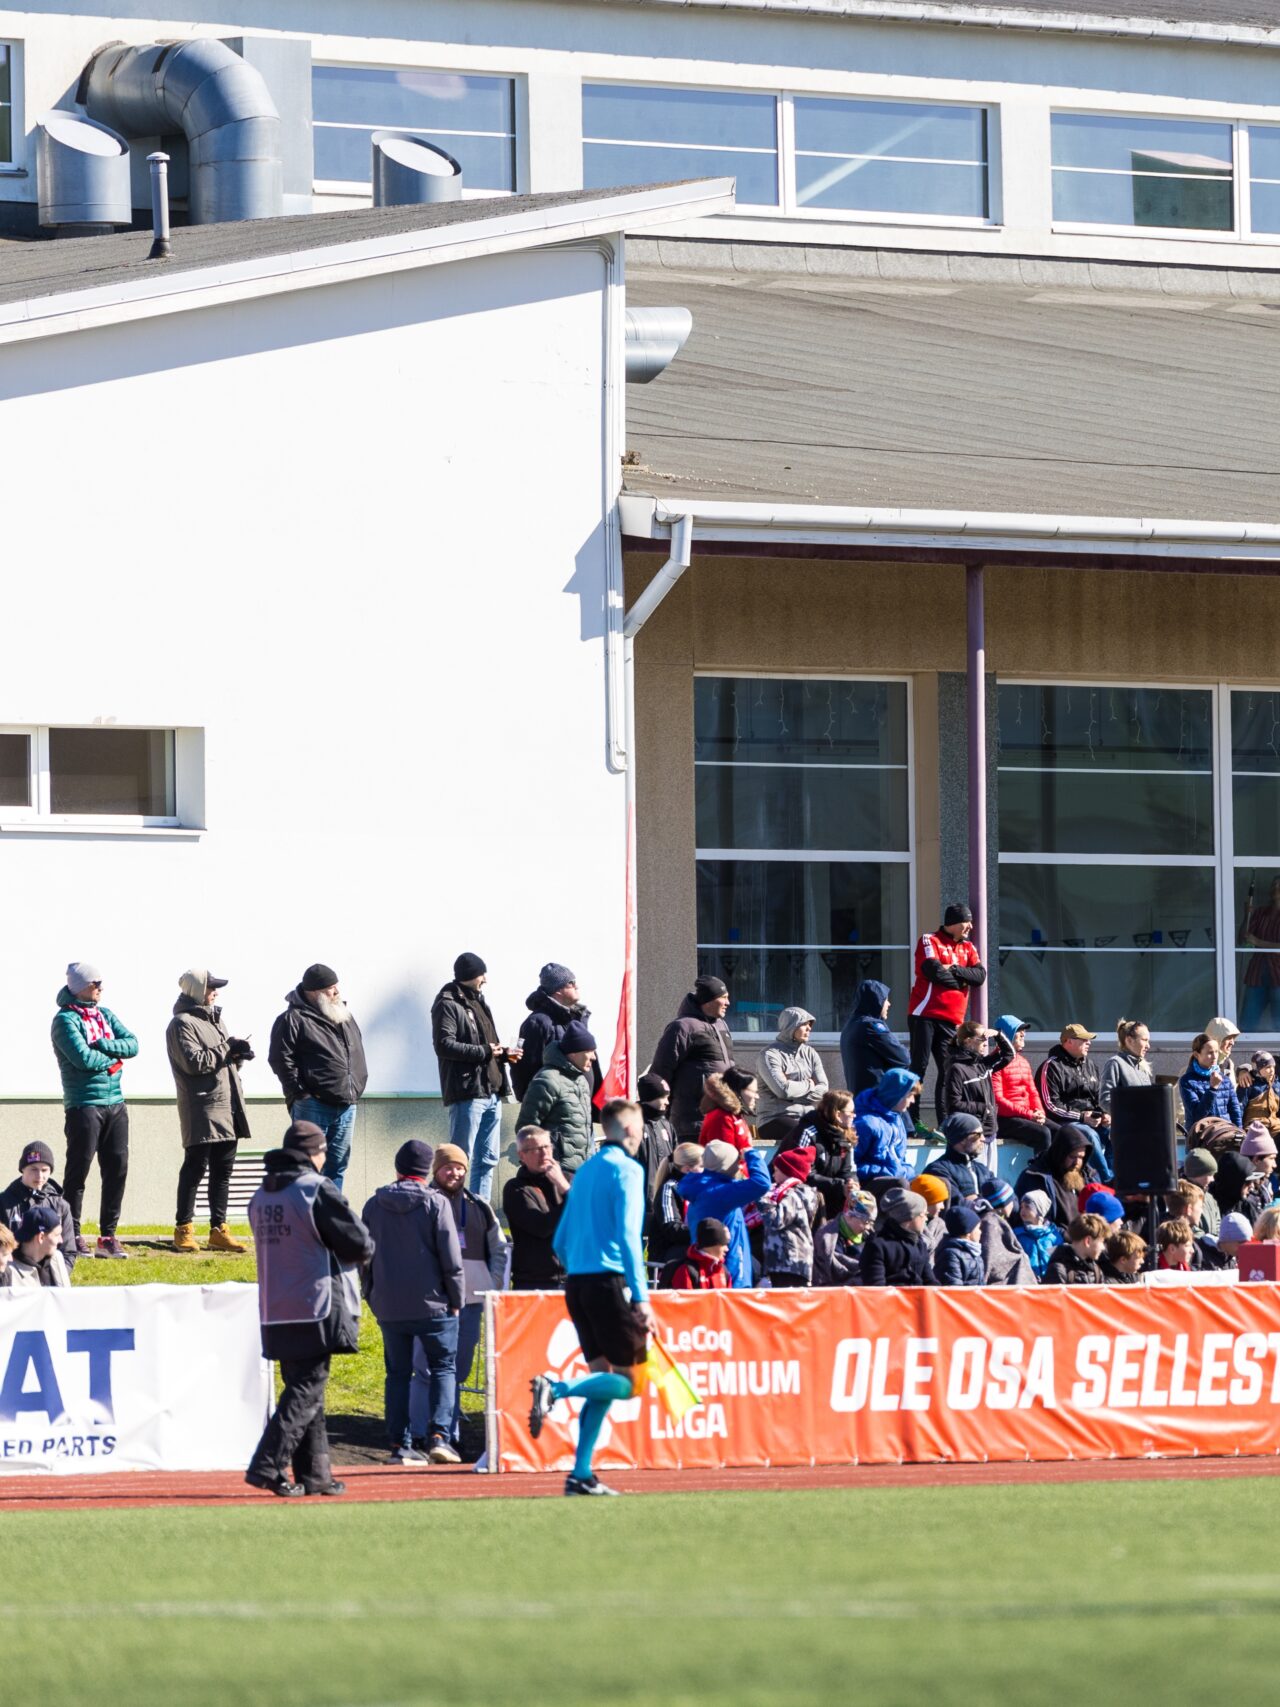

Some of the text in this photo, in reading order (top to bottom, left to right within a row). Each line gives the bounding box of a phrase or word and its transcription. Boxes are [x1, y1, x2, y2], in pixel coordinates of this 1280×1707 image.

[650, 1360, 800, 1397] EMIUM
[830, 1337, 938, 1412] OLE
[946, 1336, 1057, 1410] OSA
[0, 1435, 117, 1457] ED PARTS
